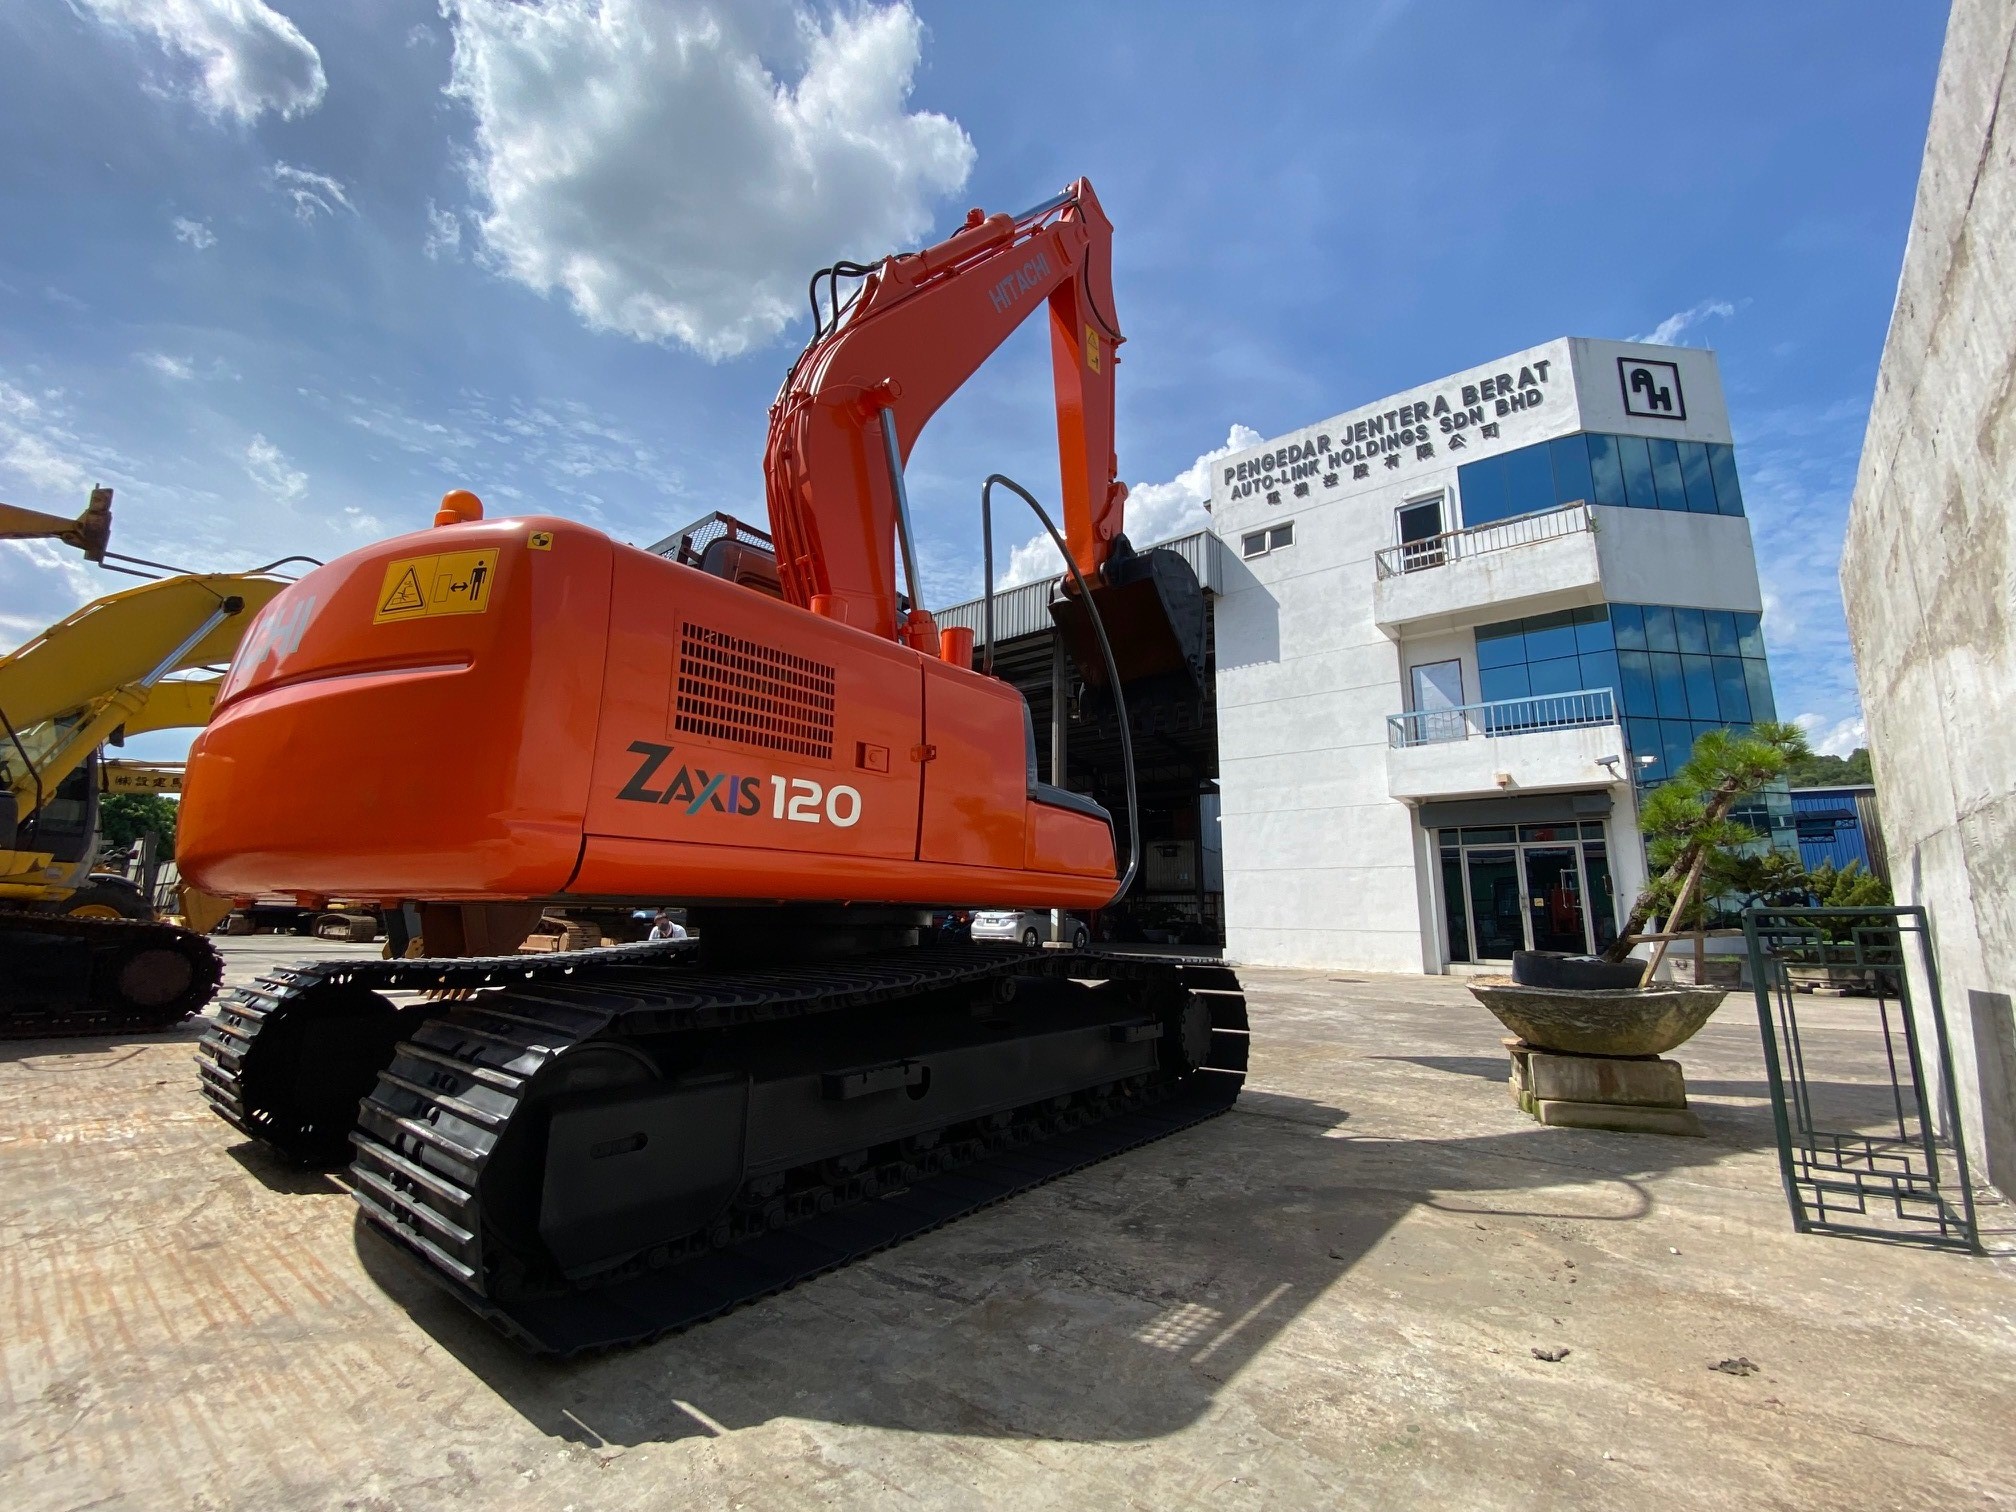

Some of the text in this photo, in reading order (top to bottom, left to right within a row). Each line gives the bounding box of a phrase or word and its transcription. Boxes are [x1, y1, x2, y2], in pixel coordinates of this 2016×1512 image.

[988, 252, 1051, 313] HITACHI
[1224, 359, 1551, 486] PENGEDAR JENTERA BERAT
[1230, 388, 1543, 501] AUTO-LINK HOLDINGS SDN BHD
[771, 774, 862, 828] 120
